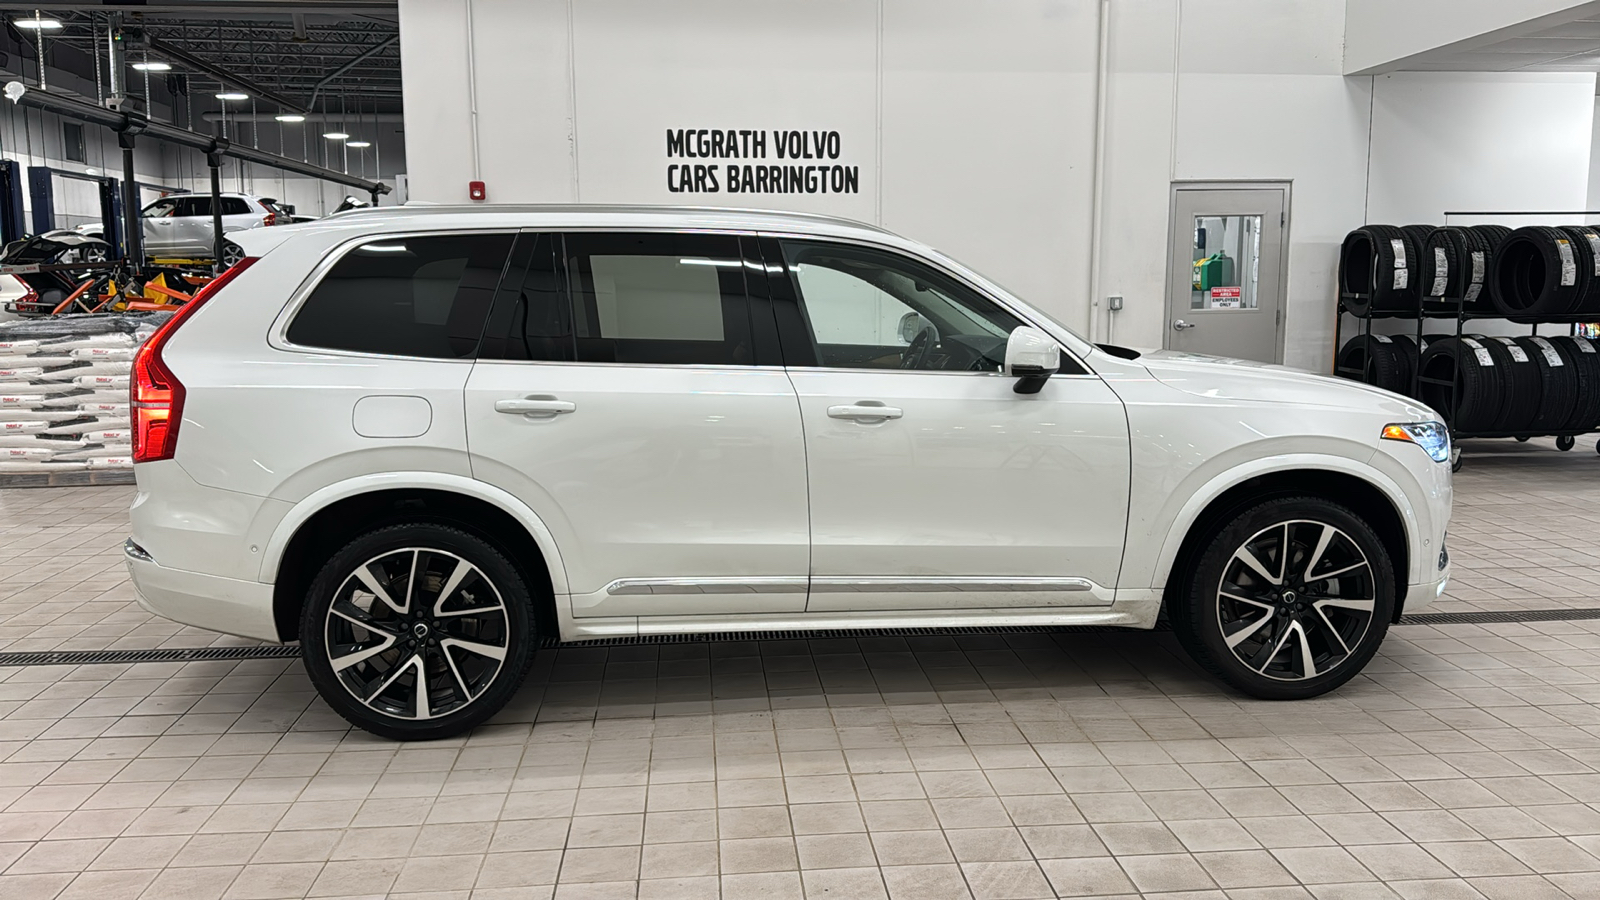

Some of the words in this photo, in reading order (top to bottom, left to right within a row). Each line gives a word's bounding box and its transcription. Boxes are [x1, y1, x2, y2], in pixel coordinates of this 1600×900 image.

[666, 129, 766, 158] MCGRATH
[773, 130, 841, 159] VOLVO
[667, 164, 720, 193] CARS
[727, 164, 859, 194] BARRINGTON
